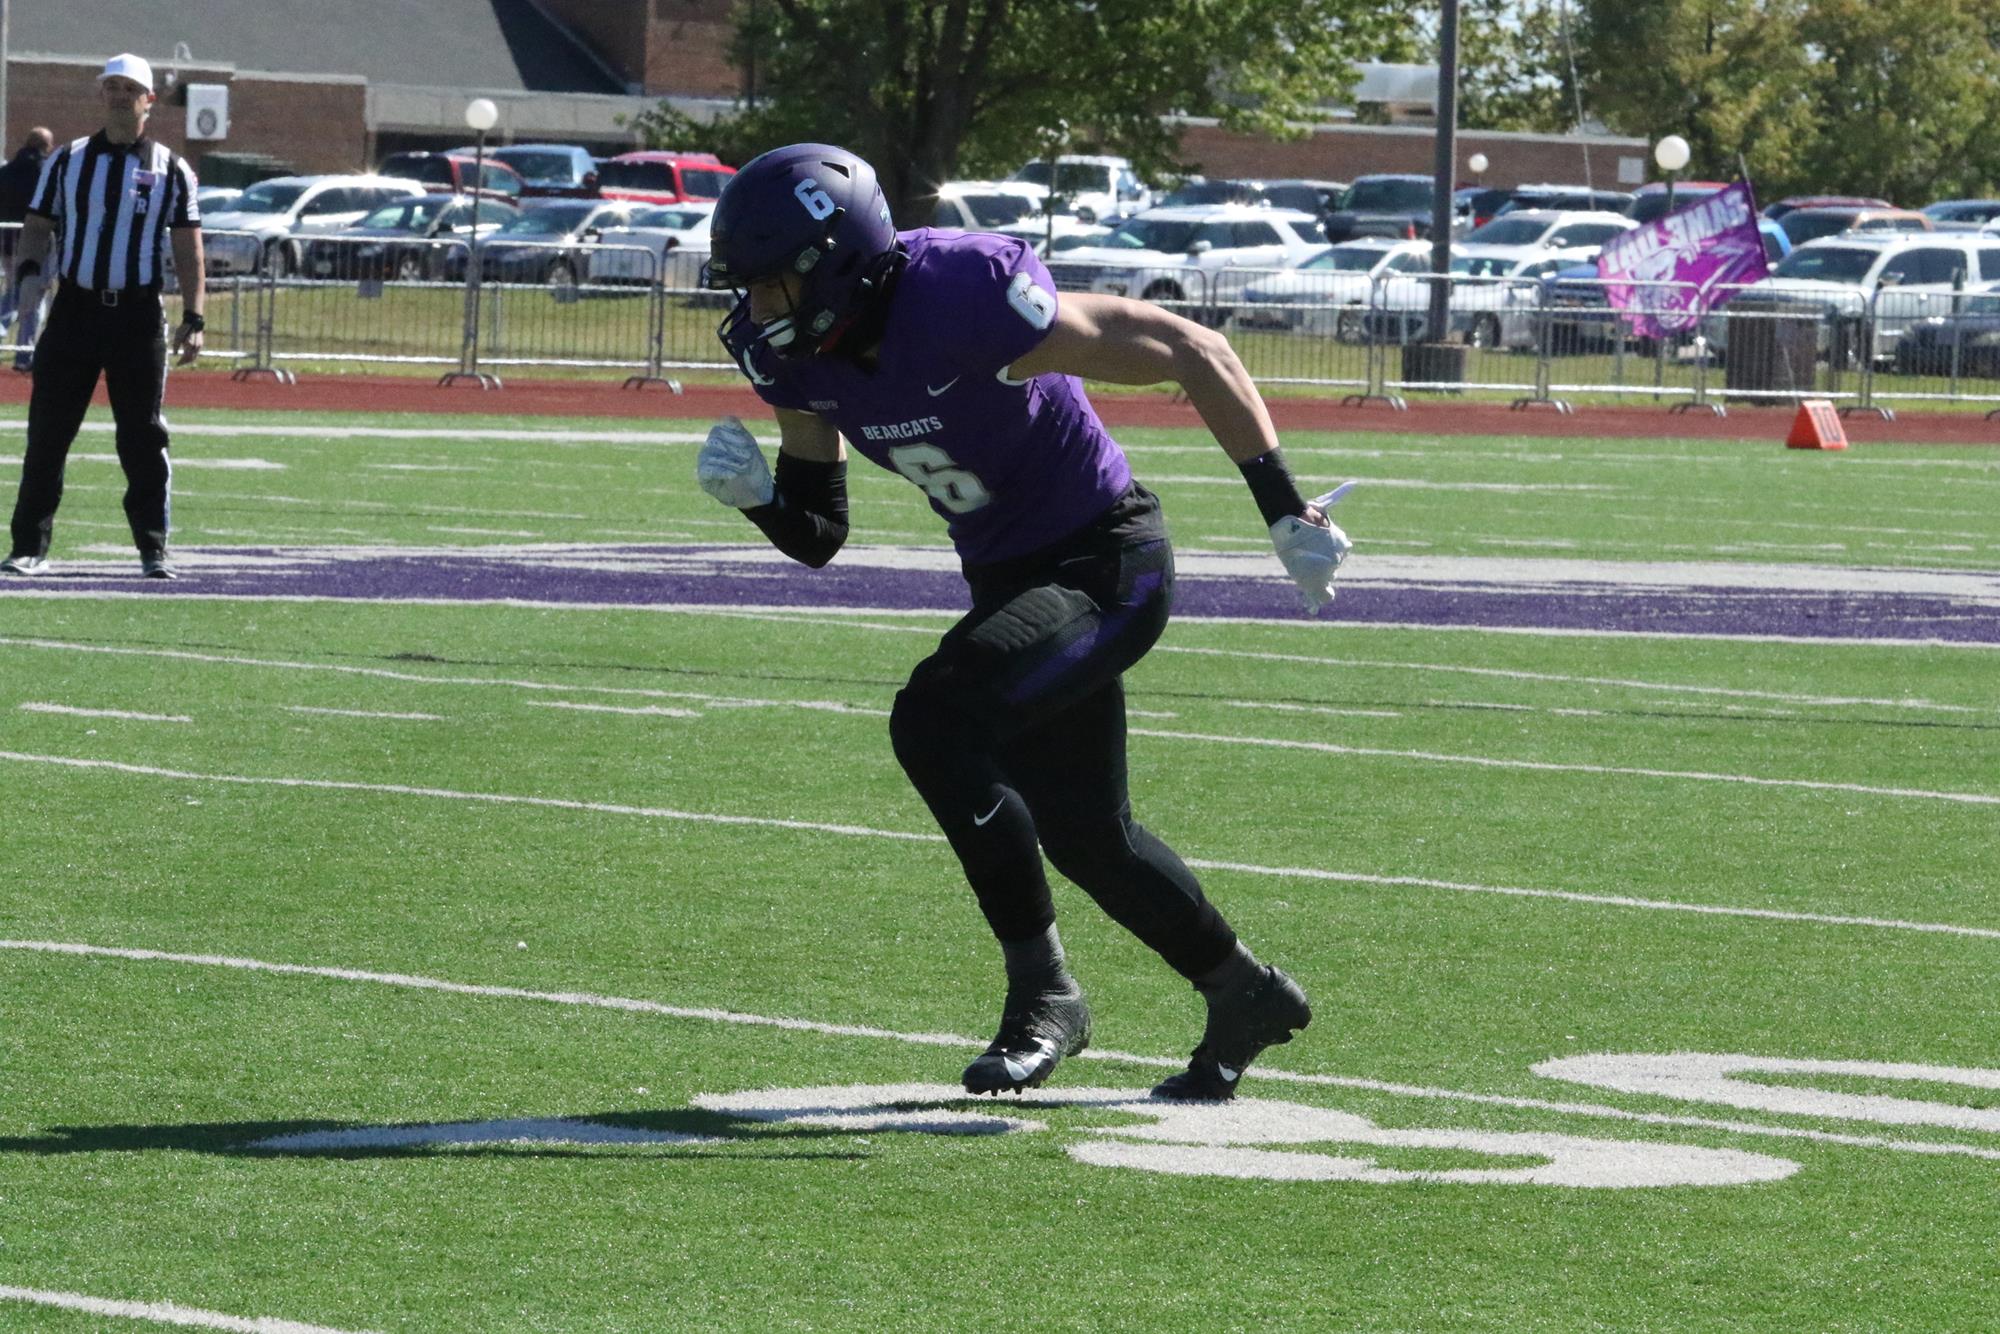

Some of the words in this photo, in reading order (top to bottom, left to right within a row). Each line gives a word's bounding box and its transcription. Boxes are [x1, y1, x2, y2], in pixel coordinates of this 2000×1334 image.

[136, 197, 147, 214] R
[794, 178, 835, 221] 6
[1006, 271, 1056, 330] 6
[861, 416, 943, 440] BEARCATS
[888, 442, 991, 514] 6
